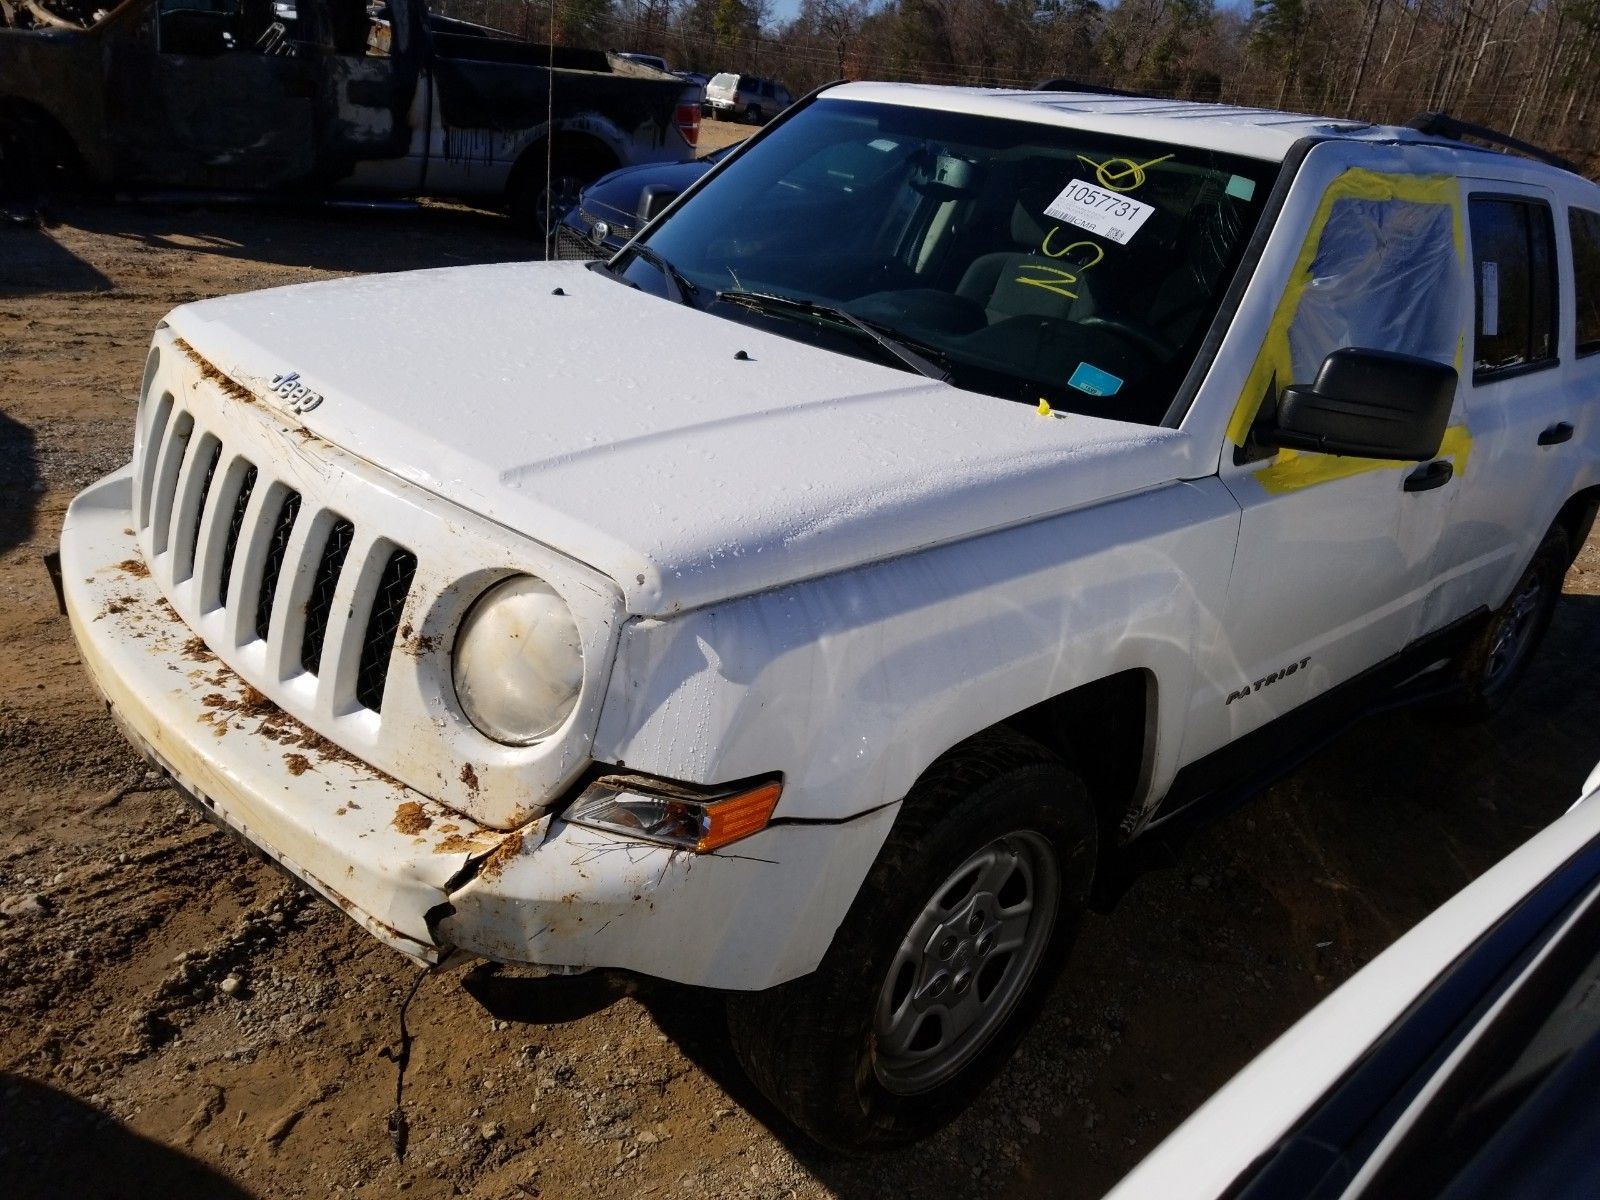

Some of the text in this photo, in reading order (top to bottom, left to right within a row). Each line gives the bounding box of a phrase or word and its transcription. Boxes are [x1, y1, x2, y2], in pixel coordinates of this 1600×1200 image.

[1065, 183, 1141, 221] 1057731
[267, 372, 324, 415] Jeep
[1225, 656, 1312, 706] PATRIOT
